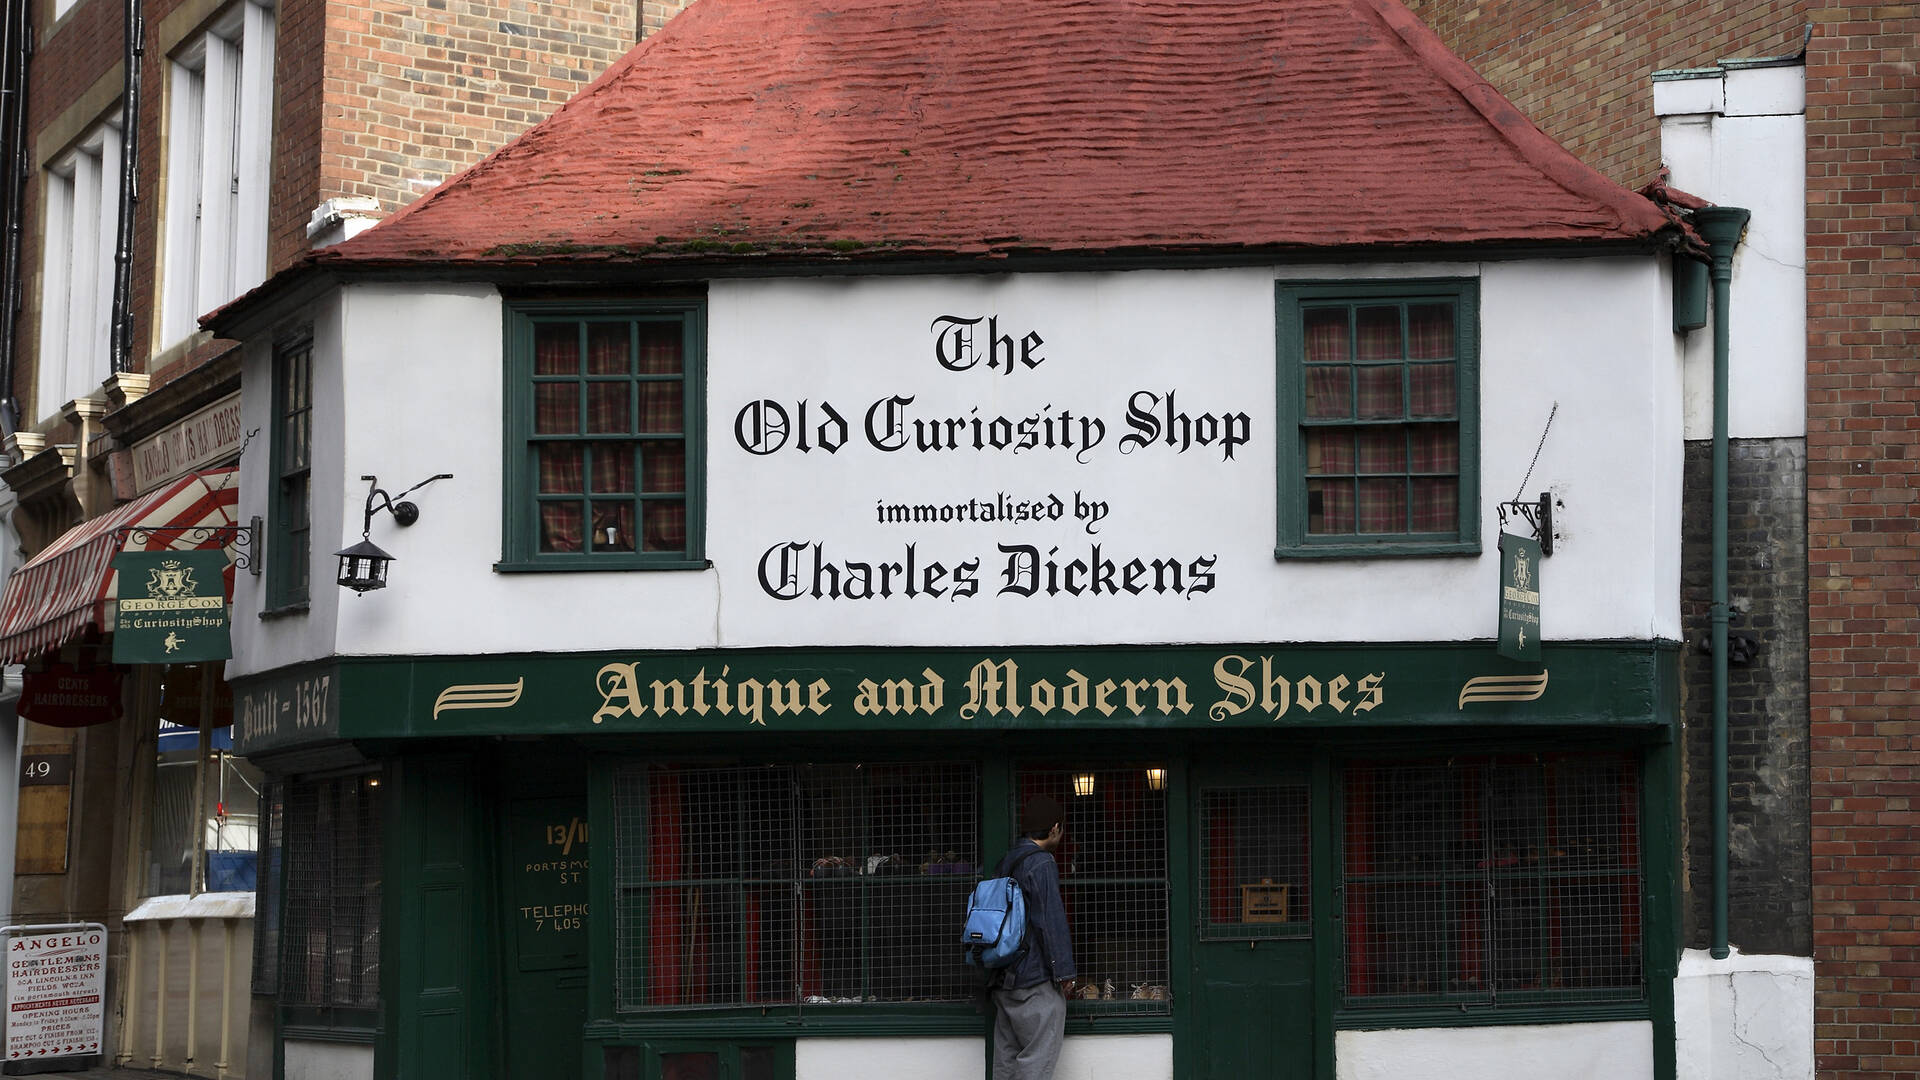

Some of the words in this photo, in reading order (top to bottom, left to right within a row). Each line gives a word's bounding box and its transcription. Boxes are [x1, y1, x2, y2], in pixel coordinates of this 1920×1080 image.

[930, 314, 1046, 375] The
[734, 398, 849, 456] Old
[864, 394, 1106, 465] Curiosity
[1118, 388, 1251, 463] Shop
[876, 491, 1065, 525] immortalised
[1074, 490, 1109, 535] by
[757, 540, 980, 603] Charles
[996, 542, 1218, 601] Dickens
[592, 661, 832, 726] Antique
[853, 667, 945, 716] and
[959, 658, 1194, 720] Modern
[1208, 654, 1386, 722] Shoes
[296, 675, 330, 729] 1567
[25, 761, 50, 778] 49
[535, 919, 544, 932] 7
[554, 917, 581, 932] 405
[12, 935, 100, 951] ANGELO
[12, 963, 100, 978] HAIRDRESSERS
[28, 984, 57, 992] FIELDS
[22, 1010, 60, 1019] OPENING
[62, 1007, 90, 1015] HOURS
[41, 1023, 71, 1032] PRICES
